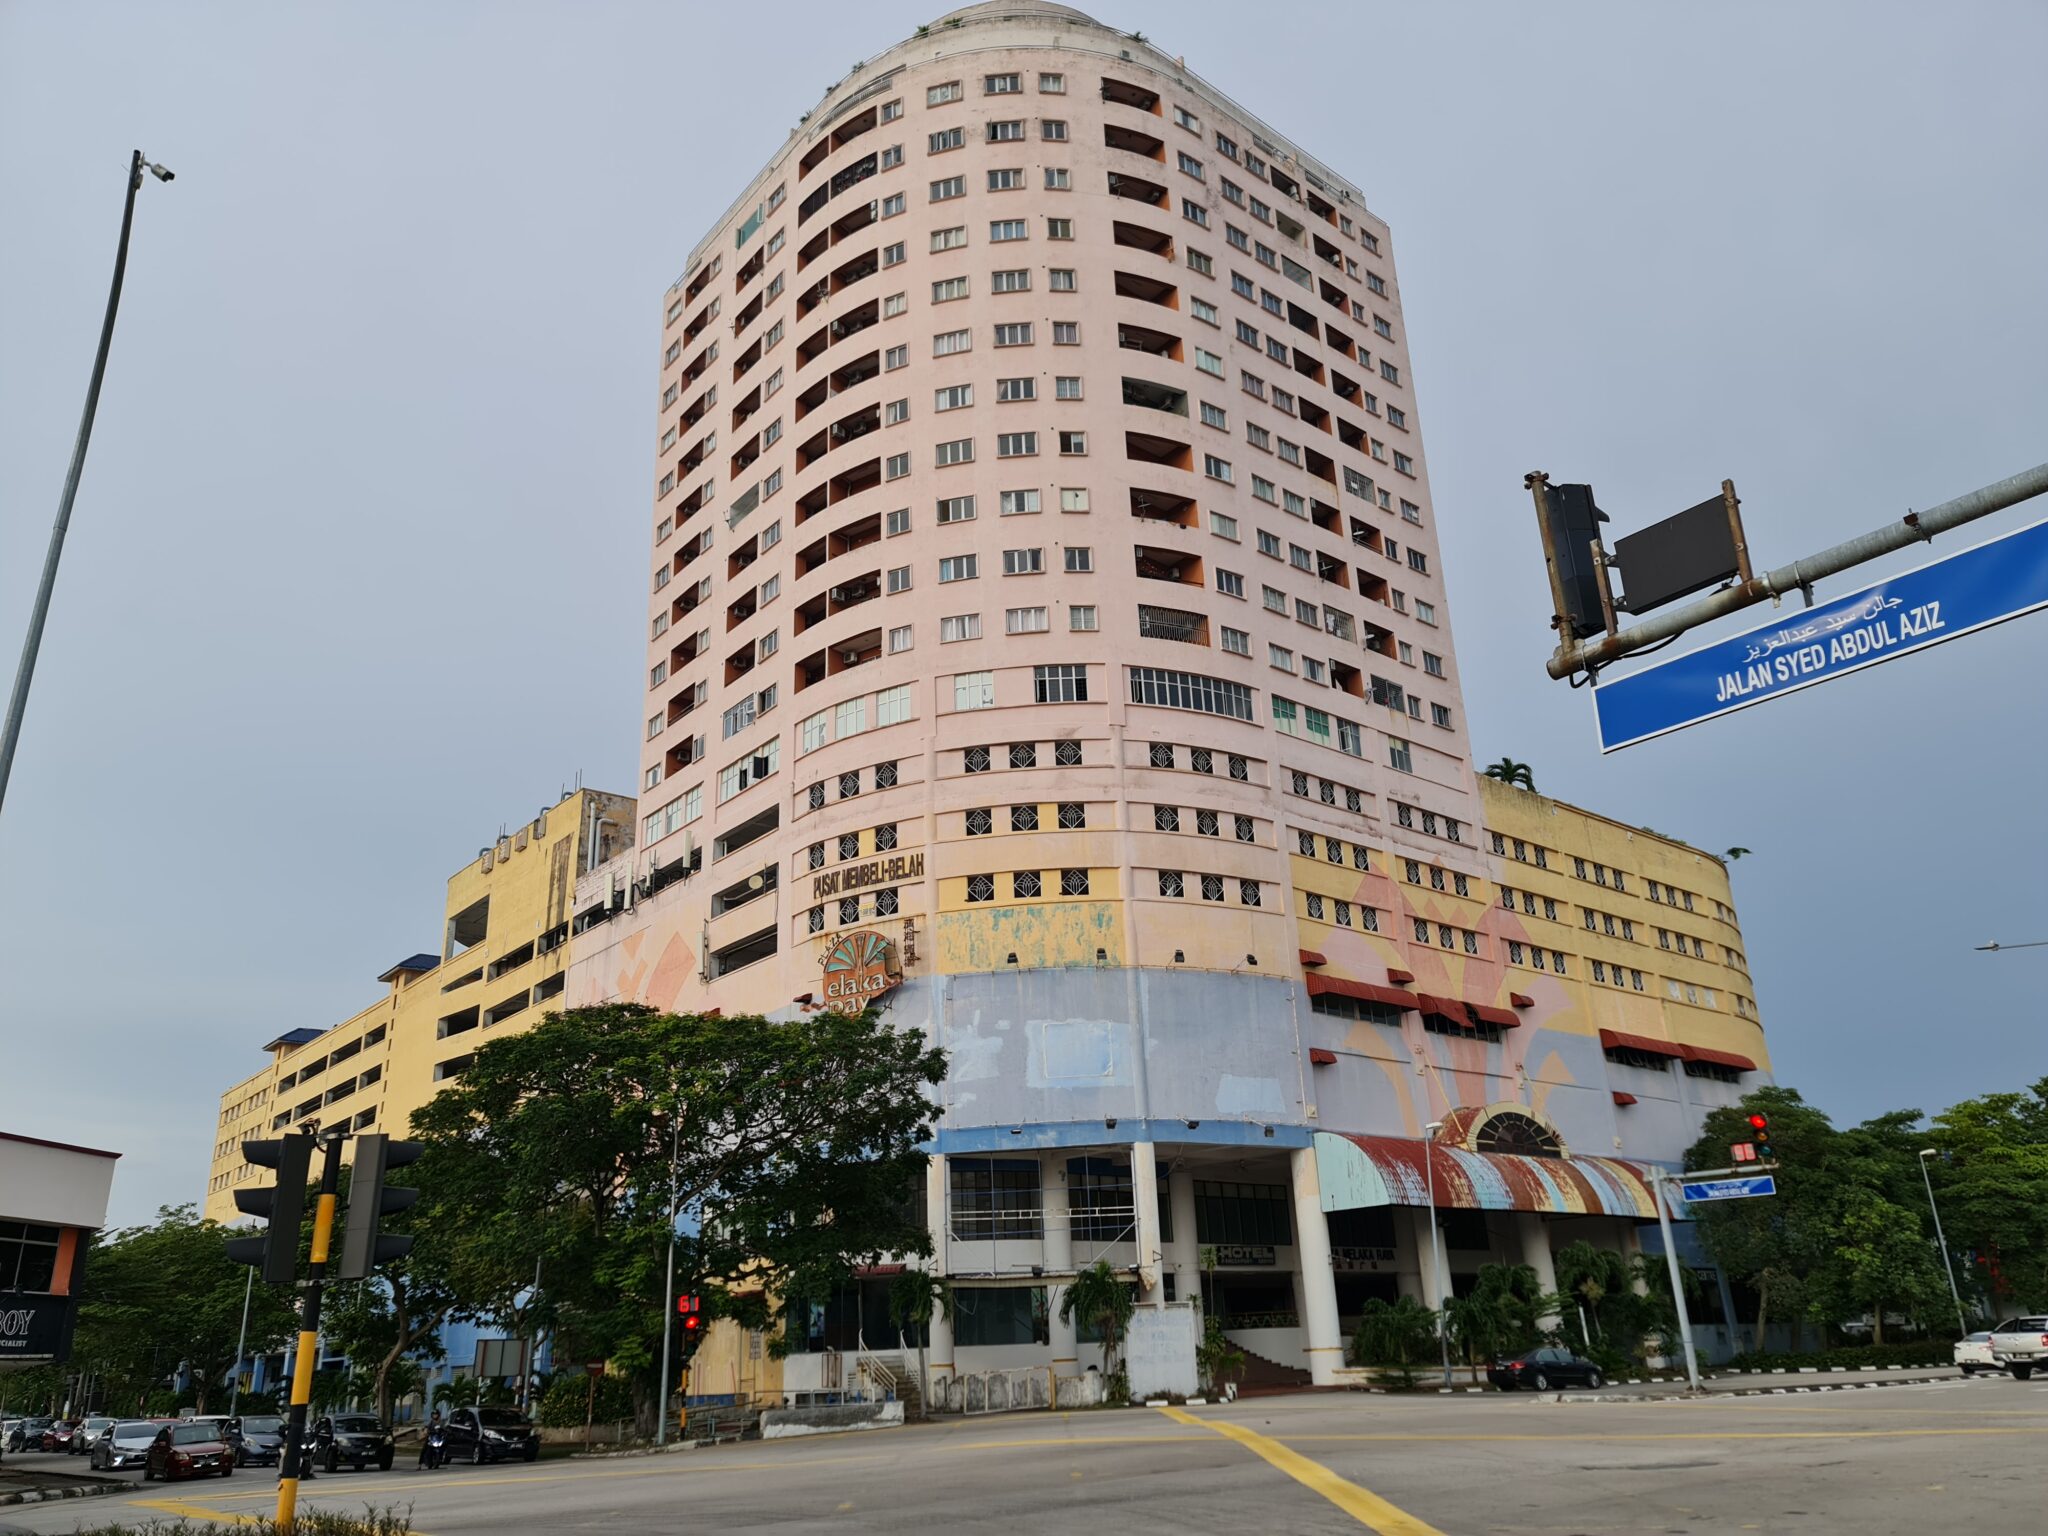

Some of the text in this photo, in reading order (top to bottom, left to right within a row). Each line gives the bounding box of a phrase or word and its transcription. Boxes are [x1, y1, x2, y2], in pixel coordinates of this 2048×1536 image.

[1716, 600, 1946, 702] JALAN SYED ABDUL AZIZ
[813, 853, 924, 900] PUSAT MEMBELI-BELAH
[818, 932, 844, 967] PLAZA
[1219, 1246, 1273, 1258] HOTEL
[679, 1295, 700, 1313] 61
